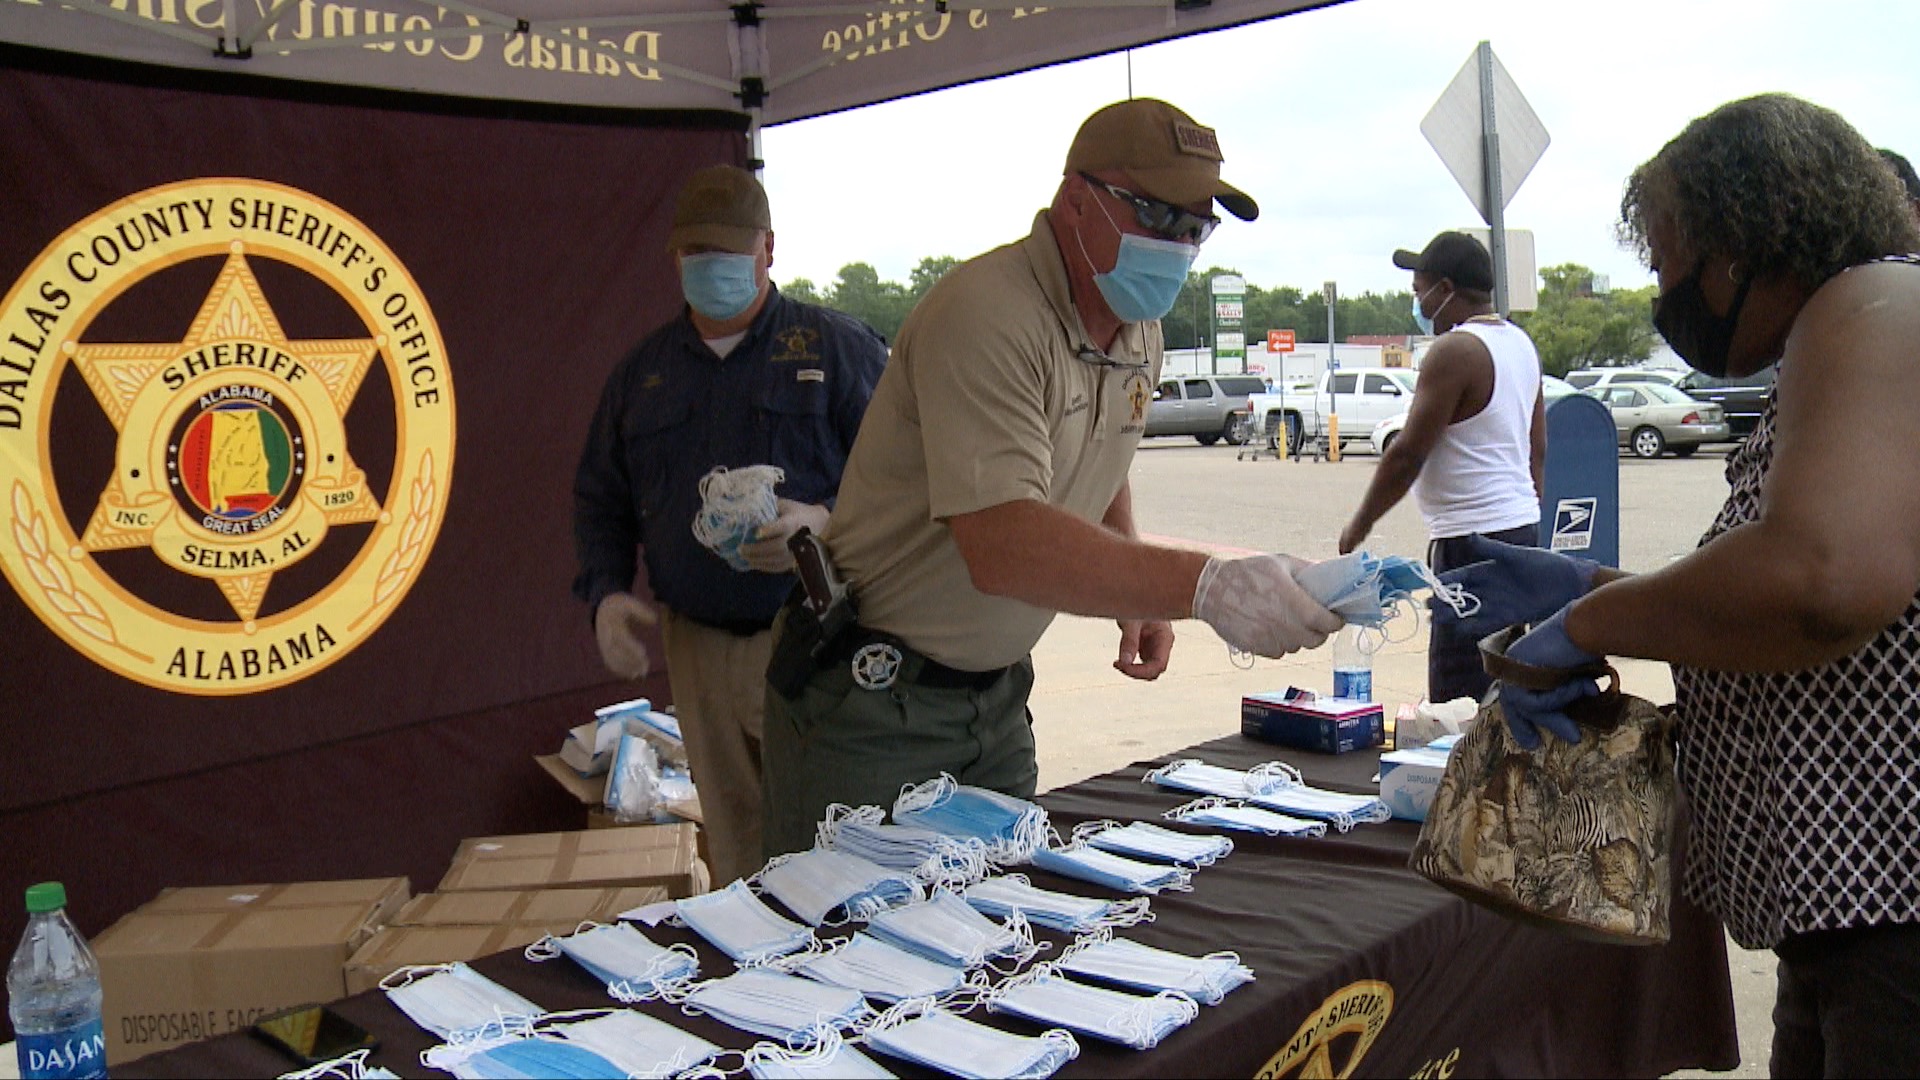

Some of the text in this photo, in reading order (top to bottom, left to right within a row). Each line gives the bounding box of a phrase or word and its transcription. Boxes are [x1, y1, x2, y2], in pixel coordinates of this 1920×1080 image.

[0, 197, 439, 430] DALLAS COUNTY SHERIFF'S OFFICE
[1271, 333, 1293, 341] Pickup
[162, 343, 307, 391] SHERIFF
[199, 385, 273, 409] ALABAMA
[323, 490, 355, 507] 1820
[115, 511, 156, 527] INC.
[202, 505, 287, 536] GREAT SEAL
[181, 530, 312, 570] SELMA, AL
[166, 622, 337, 681] ALABAMA
[121, 1010, 217, 1045] DISPOSABLE
[29, 1031, 105, 1072] DASAN
